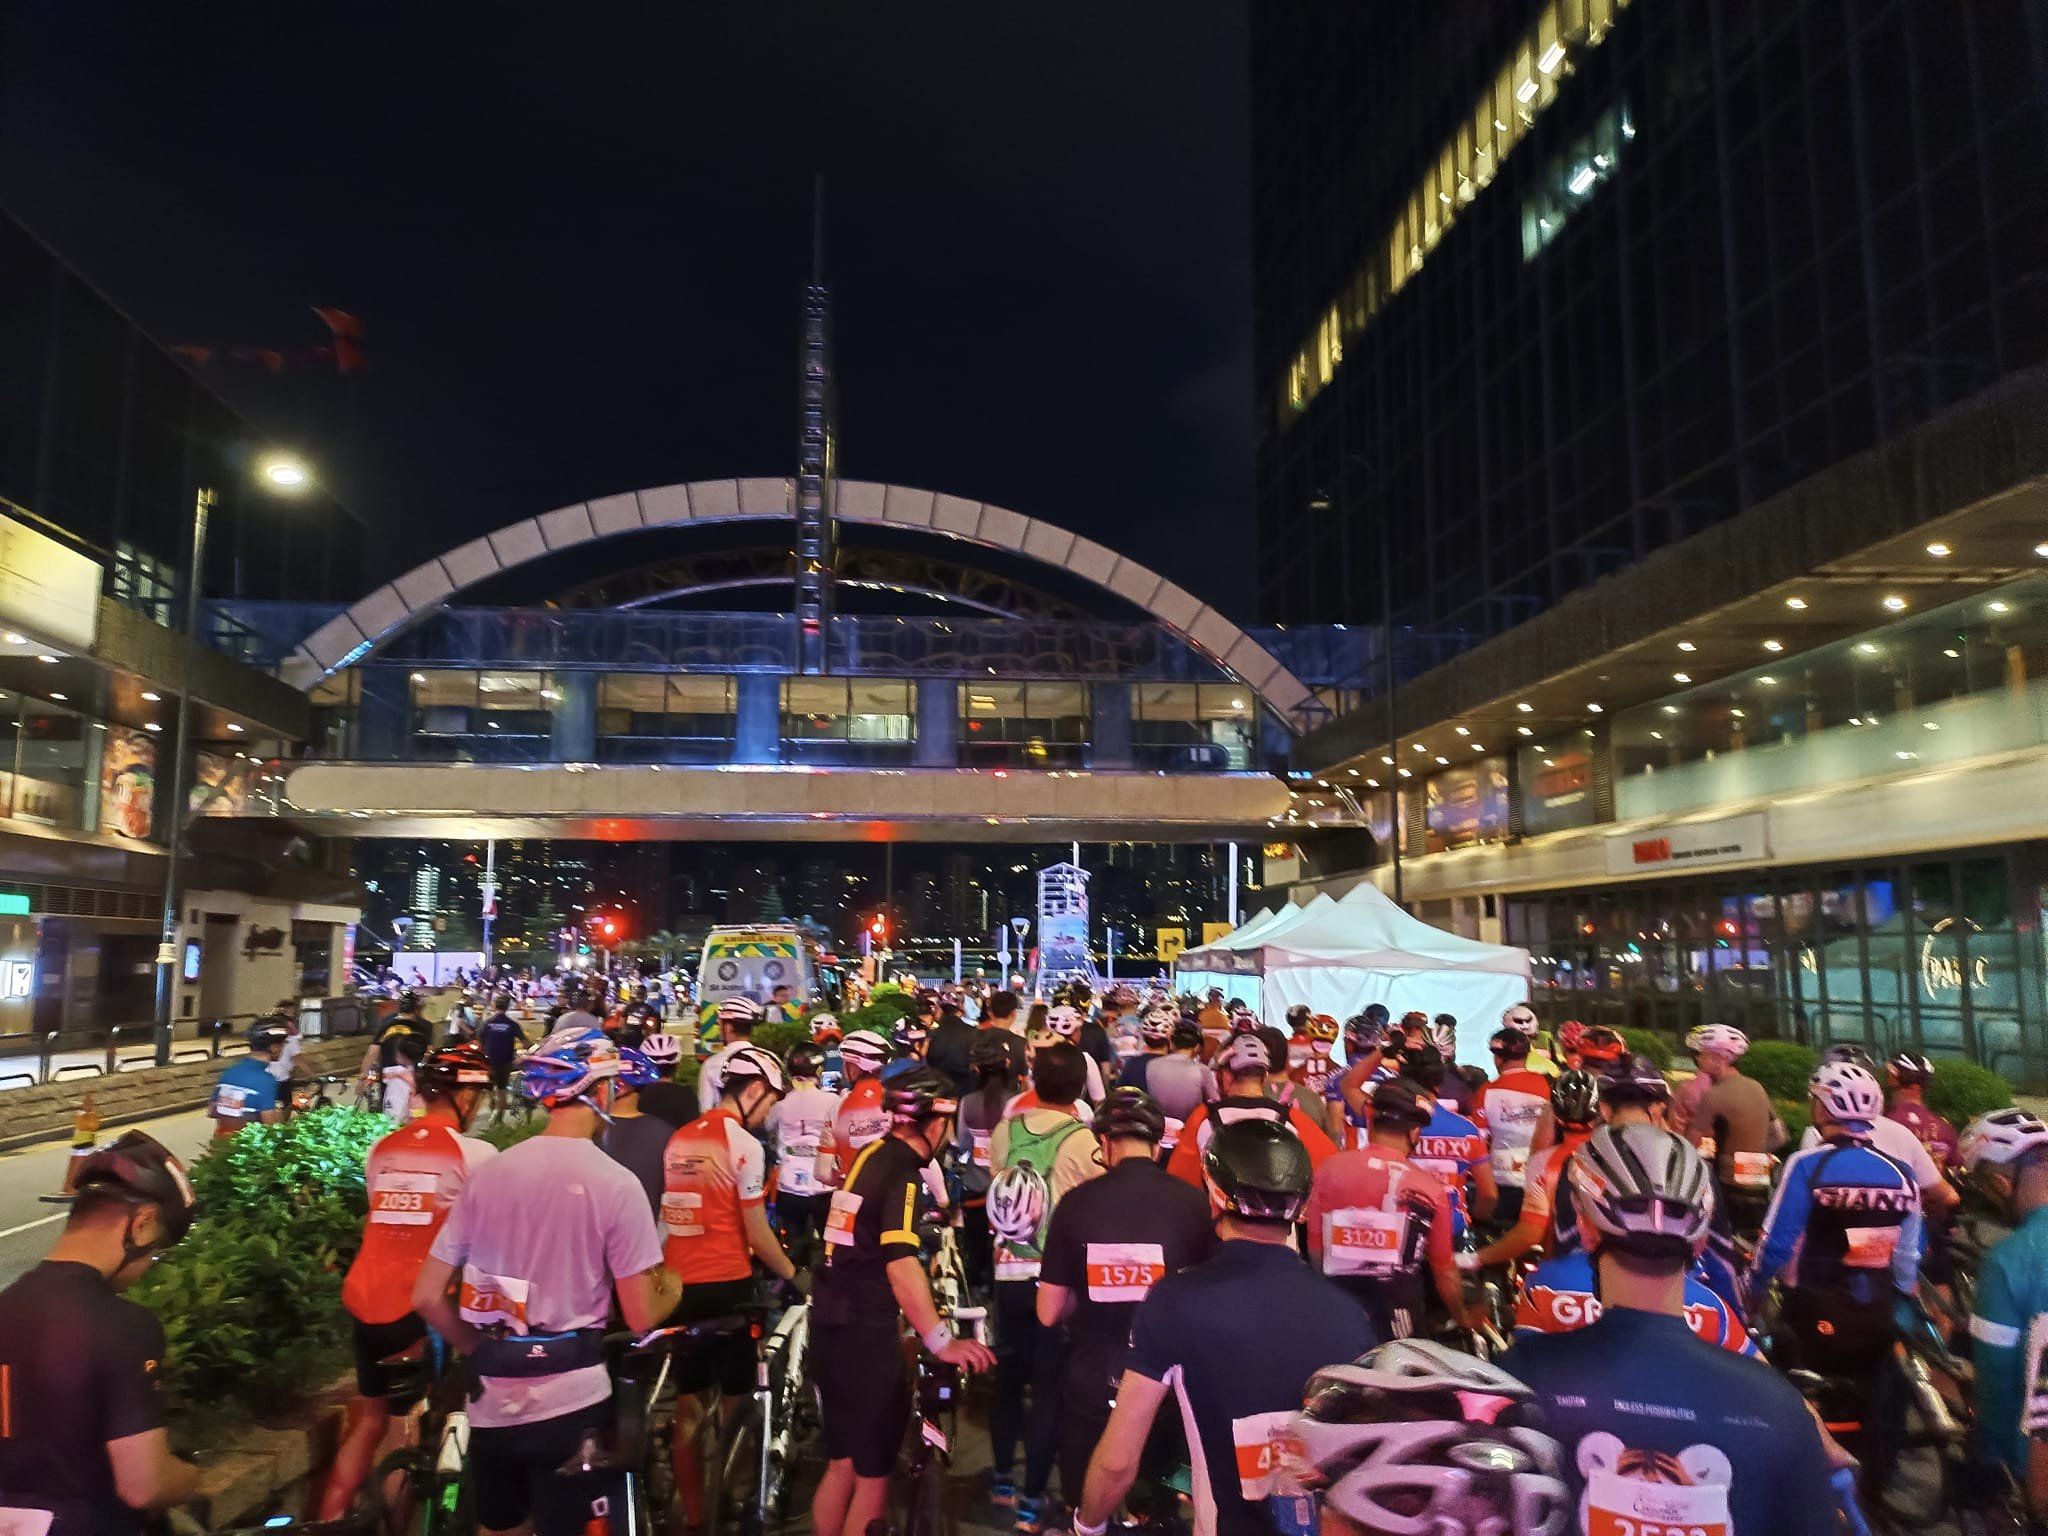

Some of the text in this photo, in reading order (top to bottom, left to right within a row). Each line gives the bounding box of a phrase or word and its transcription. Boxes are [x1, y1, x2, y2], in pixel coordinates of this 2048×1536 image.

[379, 1192, 424, 1211] 2093
[1813, 1187, 1919, 1212] GIANT
[1341, 1227, 1387, 1249] 3120
[1100, 1264, 1154, 1286] 1575
